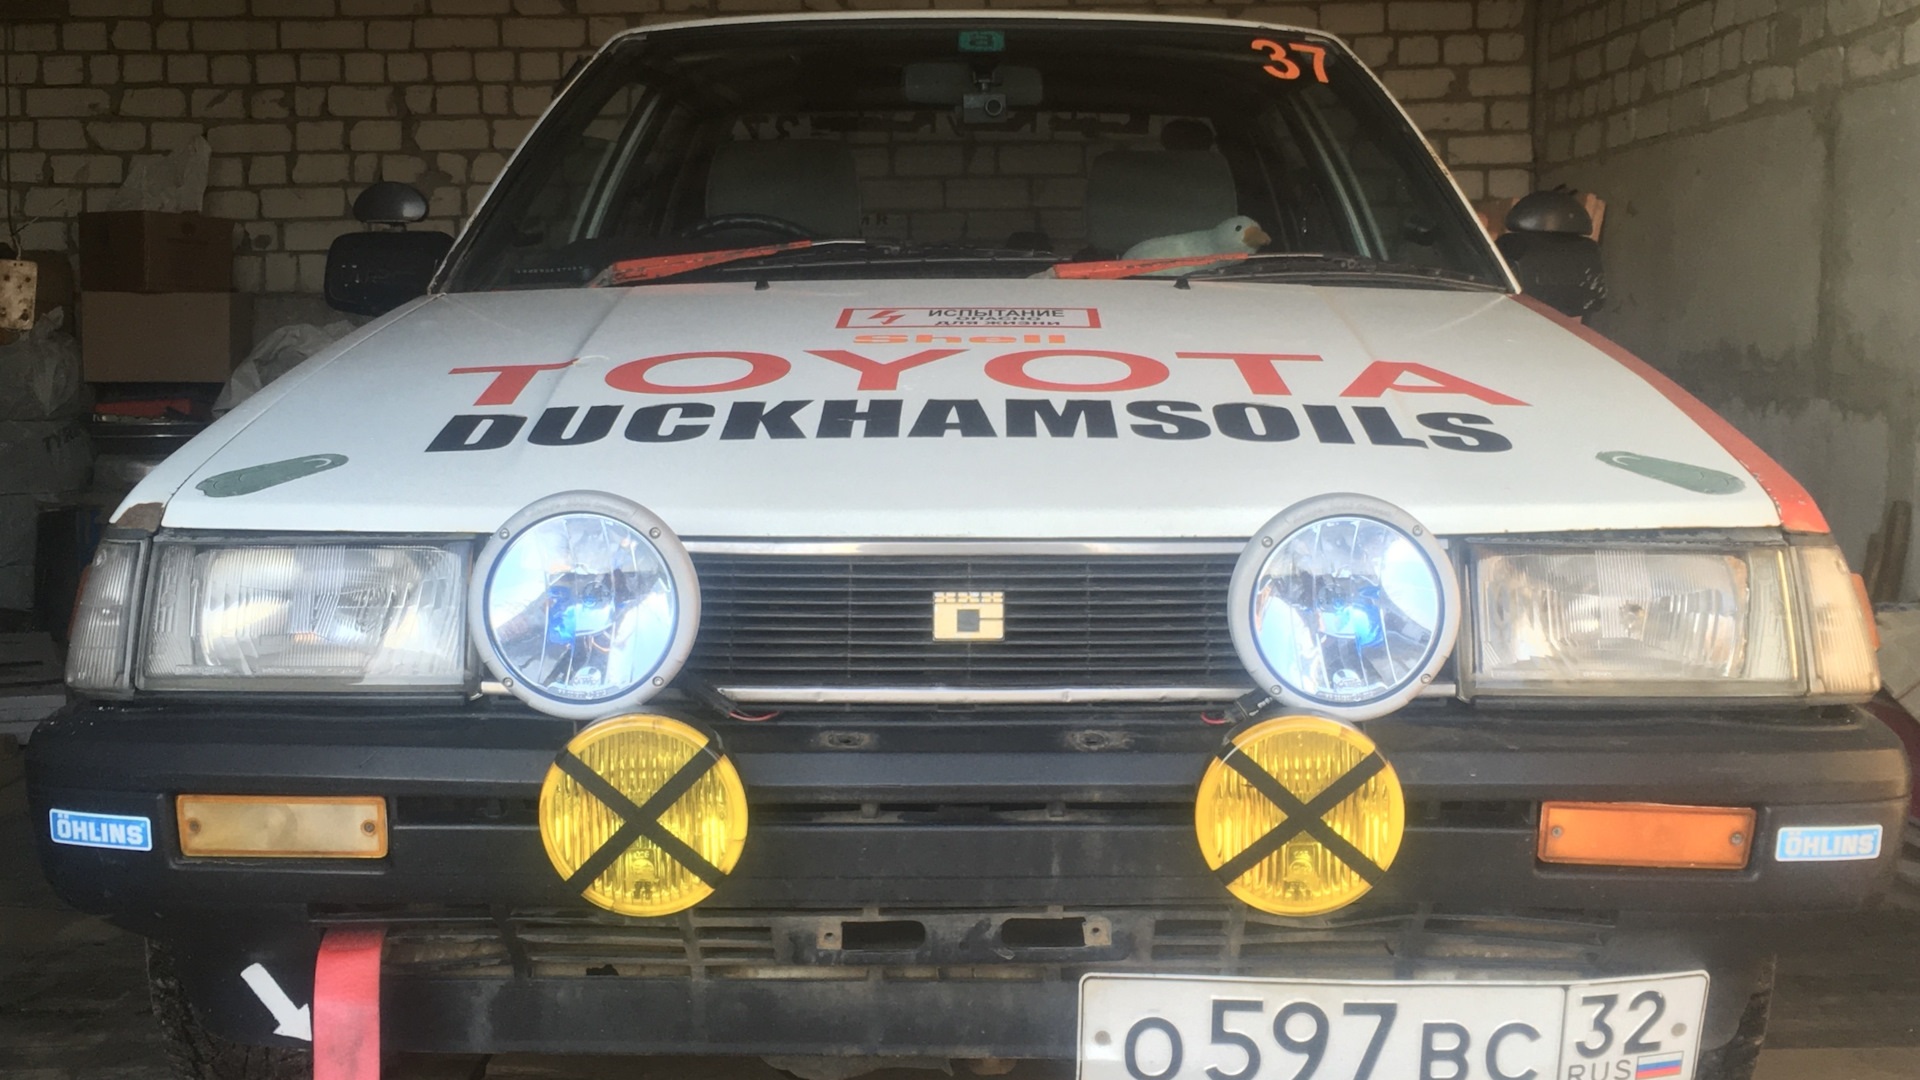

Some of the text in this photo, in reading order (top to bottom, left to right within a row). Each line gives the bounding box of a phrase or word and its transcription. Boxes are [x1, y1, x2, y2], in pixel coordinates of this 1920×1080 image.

[1250, 38, 1329, 83] 37
[928, 308, 1065, 318] ИСПЫТАНИЕ
[853, 334, 1066, 344] Shell
[448, 349, 1534, 406] TOYOTA
[56, 813, 144, 845] ÖHLINS
[1784, 829, 1875, 856] ÖHLINS
[1575, 989, 1667, 1059] 32
[1567, 1059, 1632, 1080] RUS
